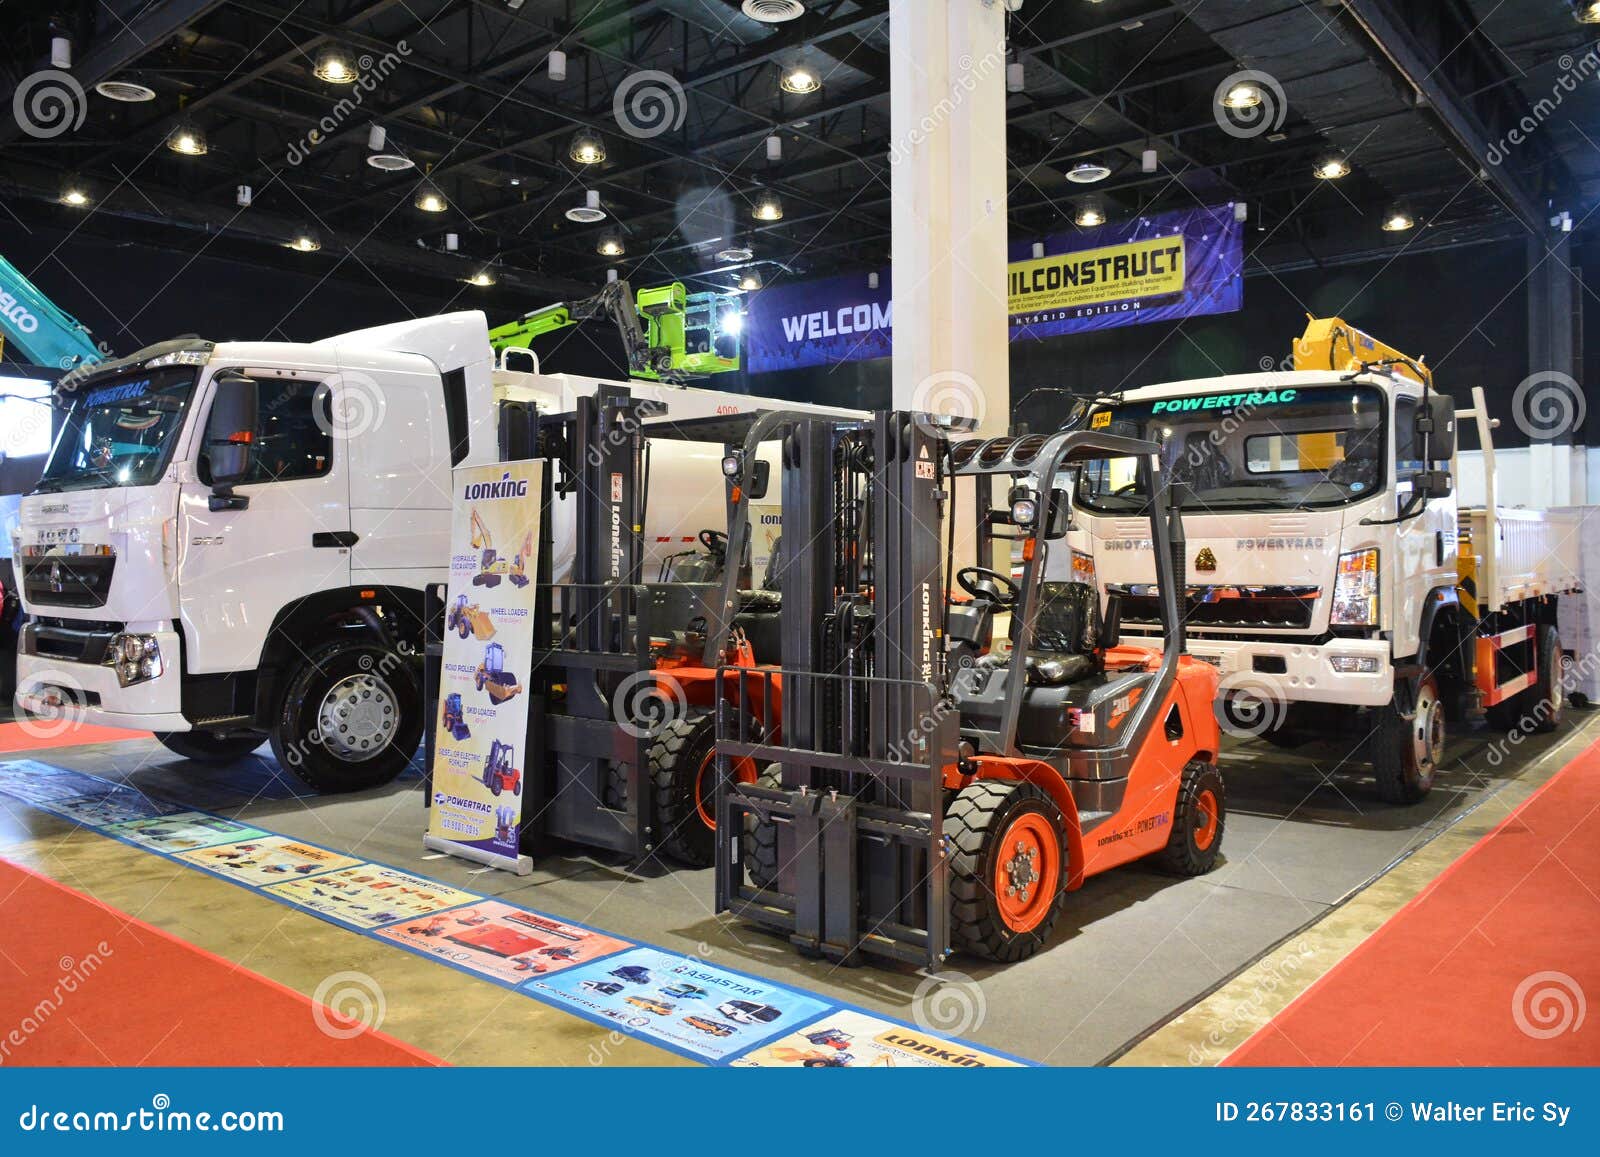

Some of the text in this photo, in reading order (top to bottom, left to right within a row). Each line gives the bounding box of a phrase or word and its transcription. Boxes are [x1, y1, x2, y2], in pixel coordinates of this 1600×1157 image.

[1008, 246, 1181, 296] ILCONSTRUCT
[1016, 302, 1140, 325] HYBRID EDITION
[1151, 389, 1297, 415] POWERTRAC
[464, 473, 528, 500] LONKING
[507, 608, 528, 617] LOADER
[457, 664, 476, 673] ROLLER
[446, 796, 492, 813] POWERTRAC
[686, 968, 764, 997] ASIASTAR
